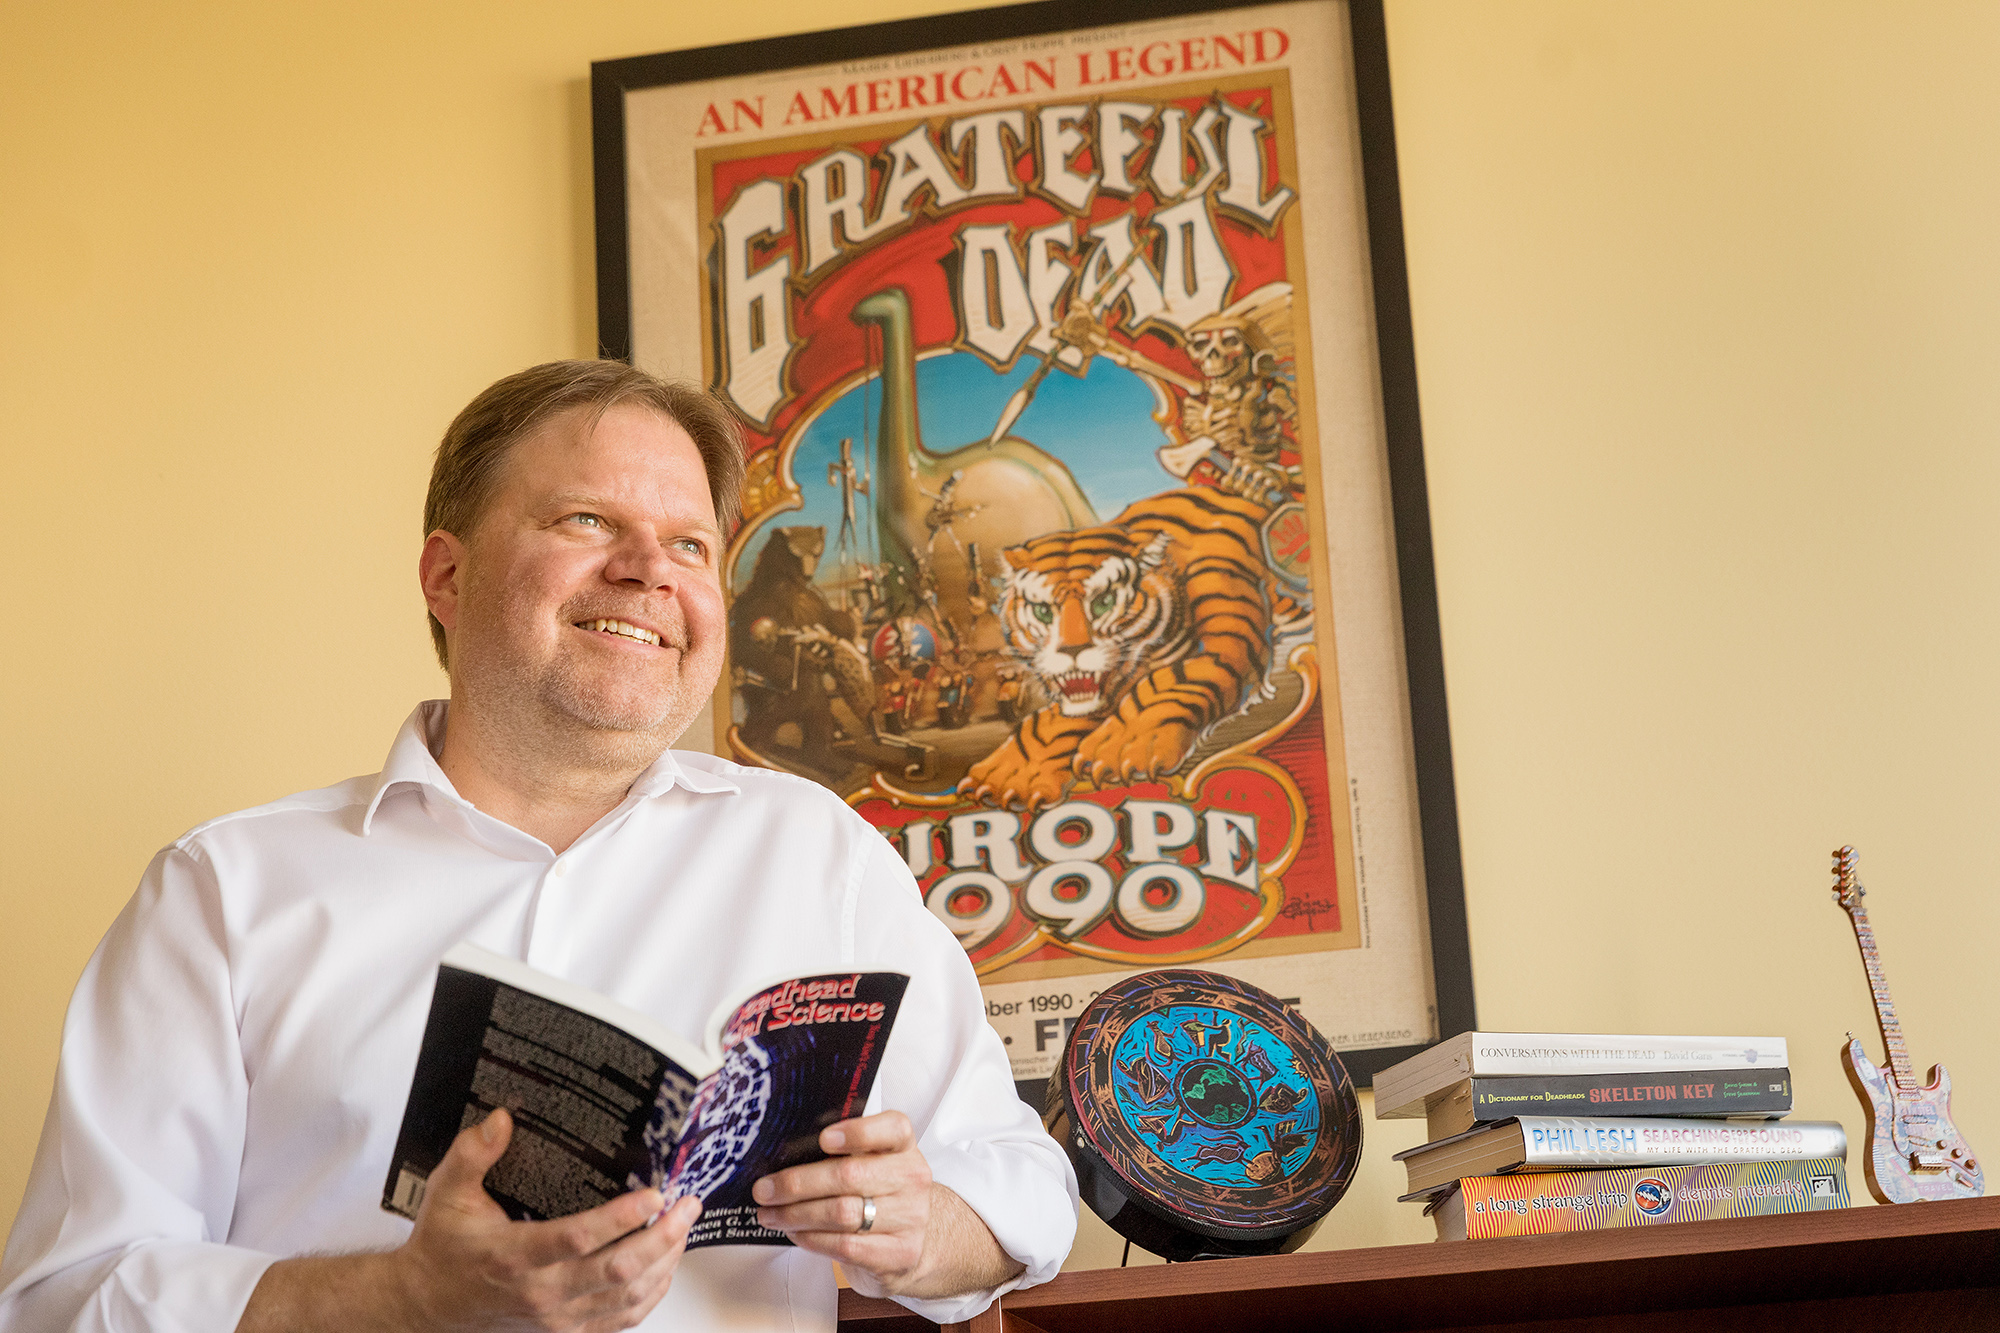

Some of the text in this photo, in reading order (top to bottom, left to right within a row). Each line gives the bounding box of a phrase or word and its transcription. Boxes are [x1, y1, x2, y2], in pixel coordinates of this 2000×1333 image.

[695, 27, 1291, 137] AN AMERICAN LEGEND
[713, 98, 1295, 425] GRATEFUL
[957, 198, 1235, 369] DEAD
[926, 859, 1204, 951] 990
[729, 975, 862, 1032] eadhead
[767, 1001, 886, 1032] Science
[984, 1000, 1022, 1016] ber
[1029, 993, 1073, 1012] 1990
[1480, 1048, 1568, 1059] CONVERSATIONS
[1570, 1049, 1600, 1059] WITH
[1603, 1049, 1625, 1059] THE
[1627, 1050, 1656, 1060] DEAD
[1664, 1050, 1689, 1060] David
[1691, 1050, 1713, 1061] Gans
[1479, 1094, 1486, 1104] A
[1589, 1084, 1677, 1103] SKELETON
[1683, 1083, 1715, 1100] KEY
[1532, 1128, 1580, 1152] PHIL
[1583, 1128, 1638, 1153] LESH
[1643, 1128, 1730, 1144] SEARCHING
[1750, 1128, 1803, 1144] SOUND
[704, 1206, 757, 1219] Edited by
[1475, 1201, 1485, 1213] a
[1489, 1197, 1527, 1215] long
[1533, 1195, 1594, 1213] strange
[1598, 1191, 1628, 1209] trip
[1679, 1183, 1734, 1201] dennis
[1738, 1179, 1802, 1198] mcnally
